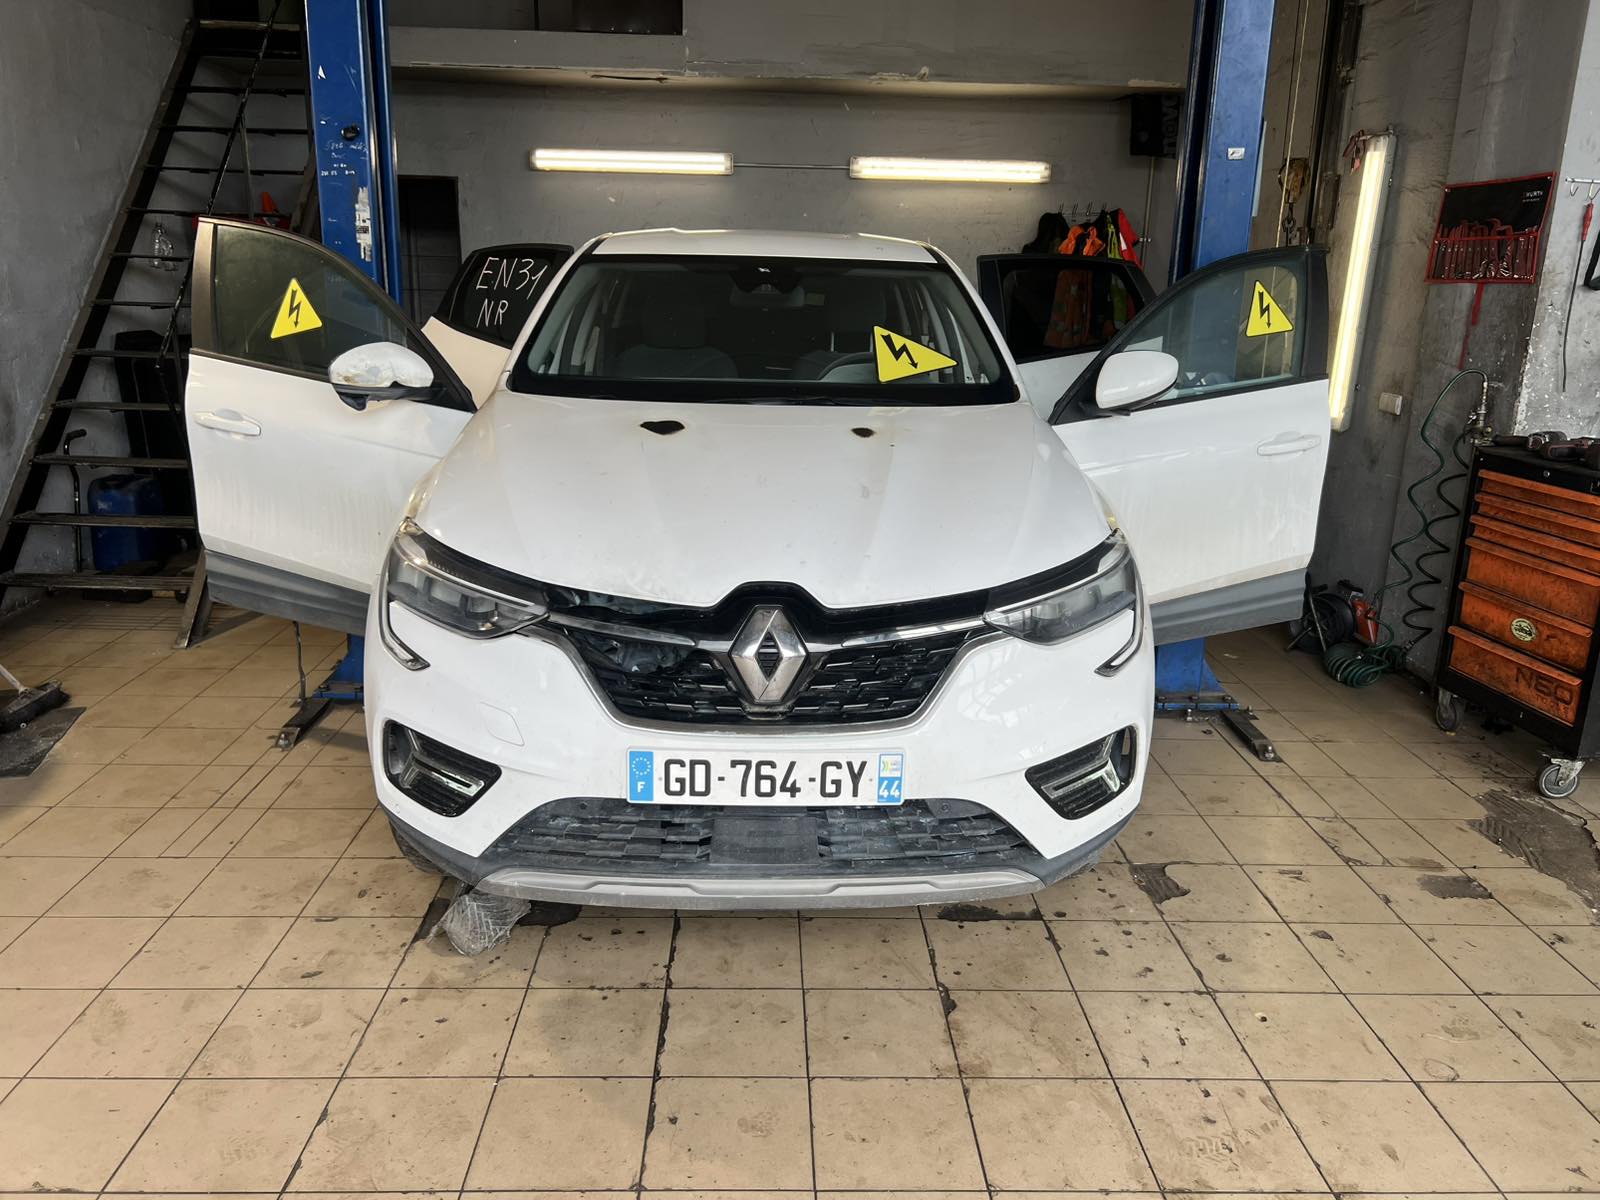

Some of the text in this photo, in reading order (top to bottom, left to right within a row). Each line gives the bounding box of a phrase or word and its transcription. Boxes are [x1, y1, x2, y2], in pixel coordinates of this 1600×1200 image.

[476, 257, 548, 300] EN31
[476, 298, 509, 328] NR
[637, 781, 646, 793] F
[663, 758, 868, 799] GD-764-GY
[879, 780, 900, 798] 44
